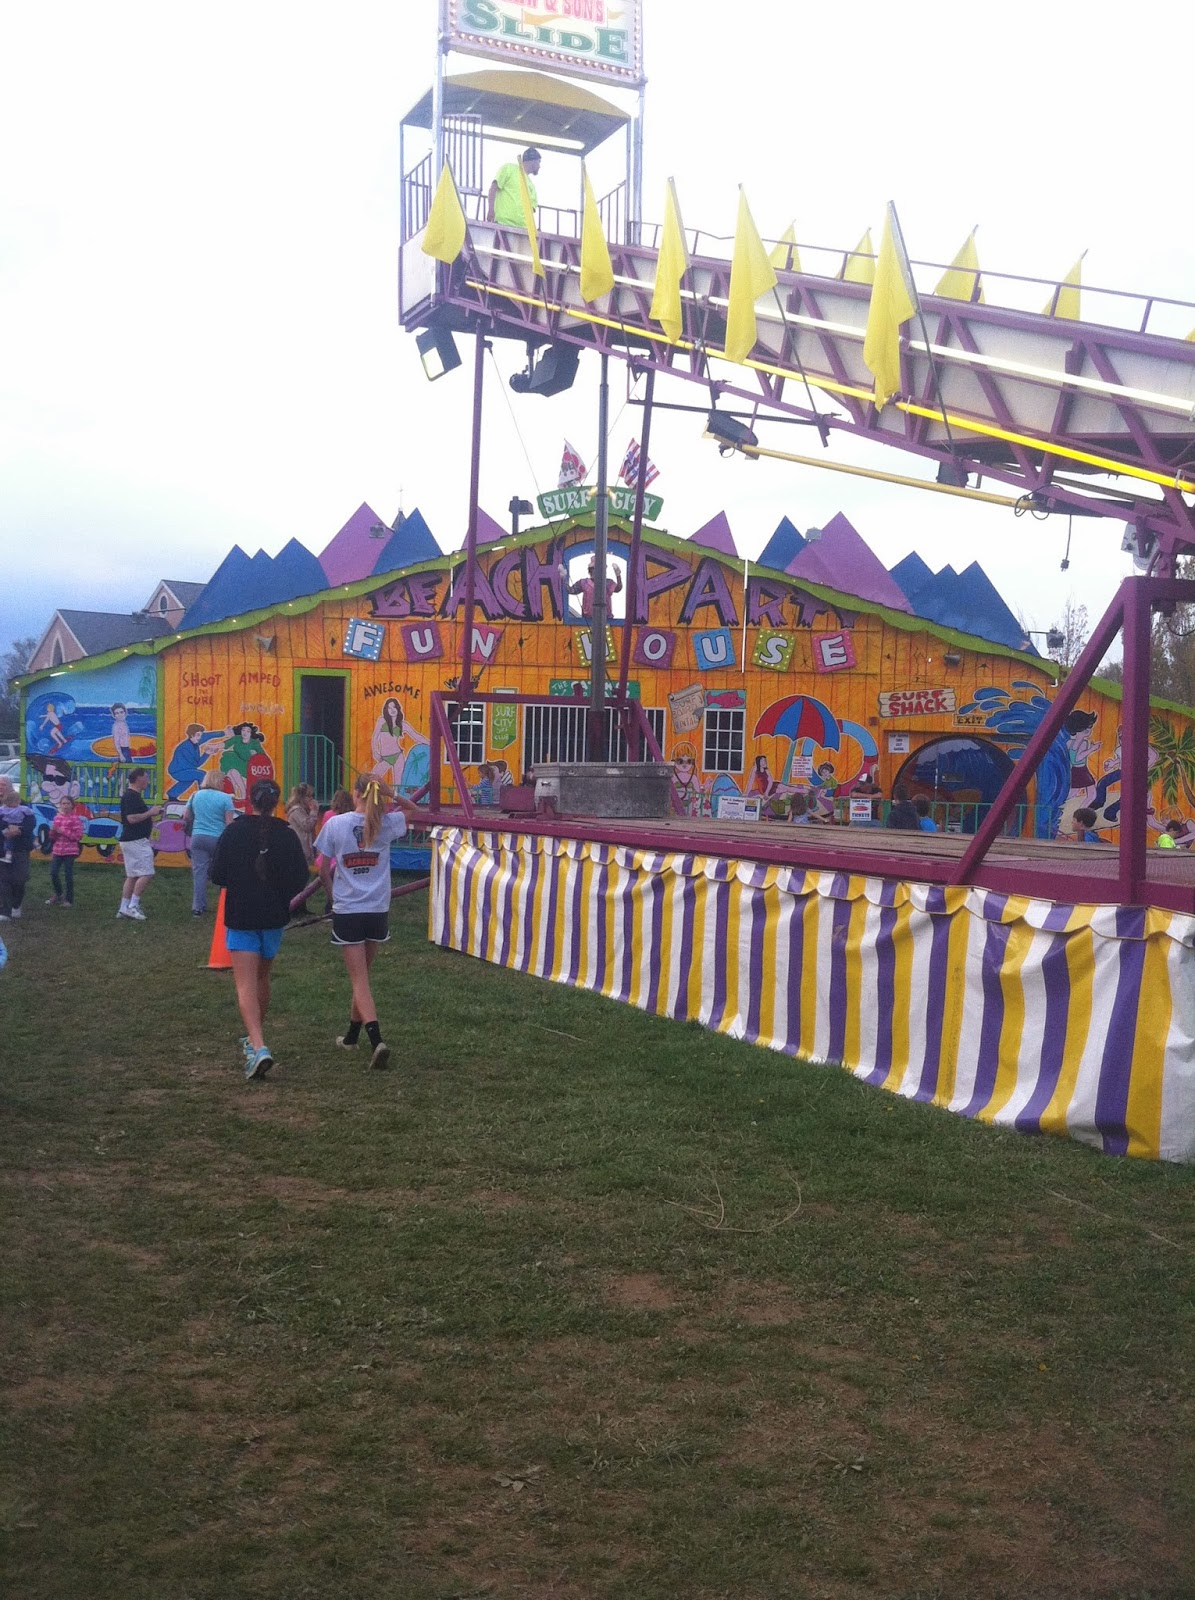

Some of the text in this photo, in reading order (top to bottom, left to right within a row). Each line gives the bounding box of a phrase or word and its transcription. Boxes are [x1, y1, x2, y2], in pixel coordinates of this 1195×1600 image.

[462, 0, 629, 63] SLIDE
[542, 489, 656, 516] SURF CITY
[366, 537, 861, 628] BEACH PARTY
[351, 623, 495, 658] FUN
[182, 672, 221, 687] SHOOT
[239, 672, 281, 687] AMPED
[552, 681, 568, 690] THE
[364, 681, 420, 700] AWESOME
[888, 690, 945, 702] SURF
[495, 705, 516, 718] SURF
[888, 697, 948, 717] SHACK
[493, 719, 515, 727] CITY
[957, 715, 982, 724] EXIT
[251, 765, 271, 775] BOSS
